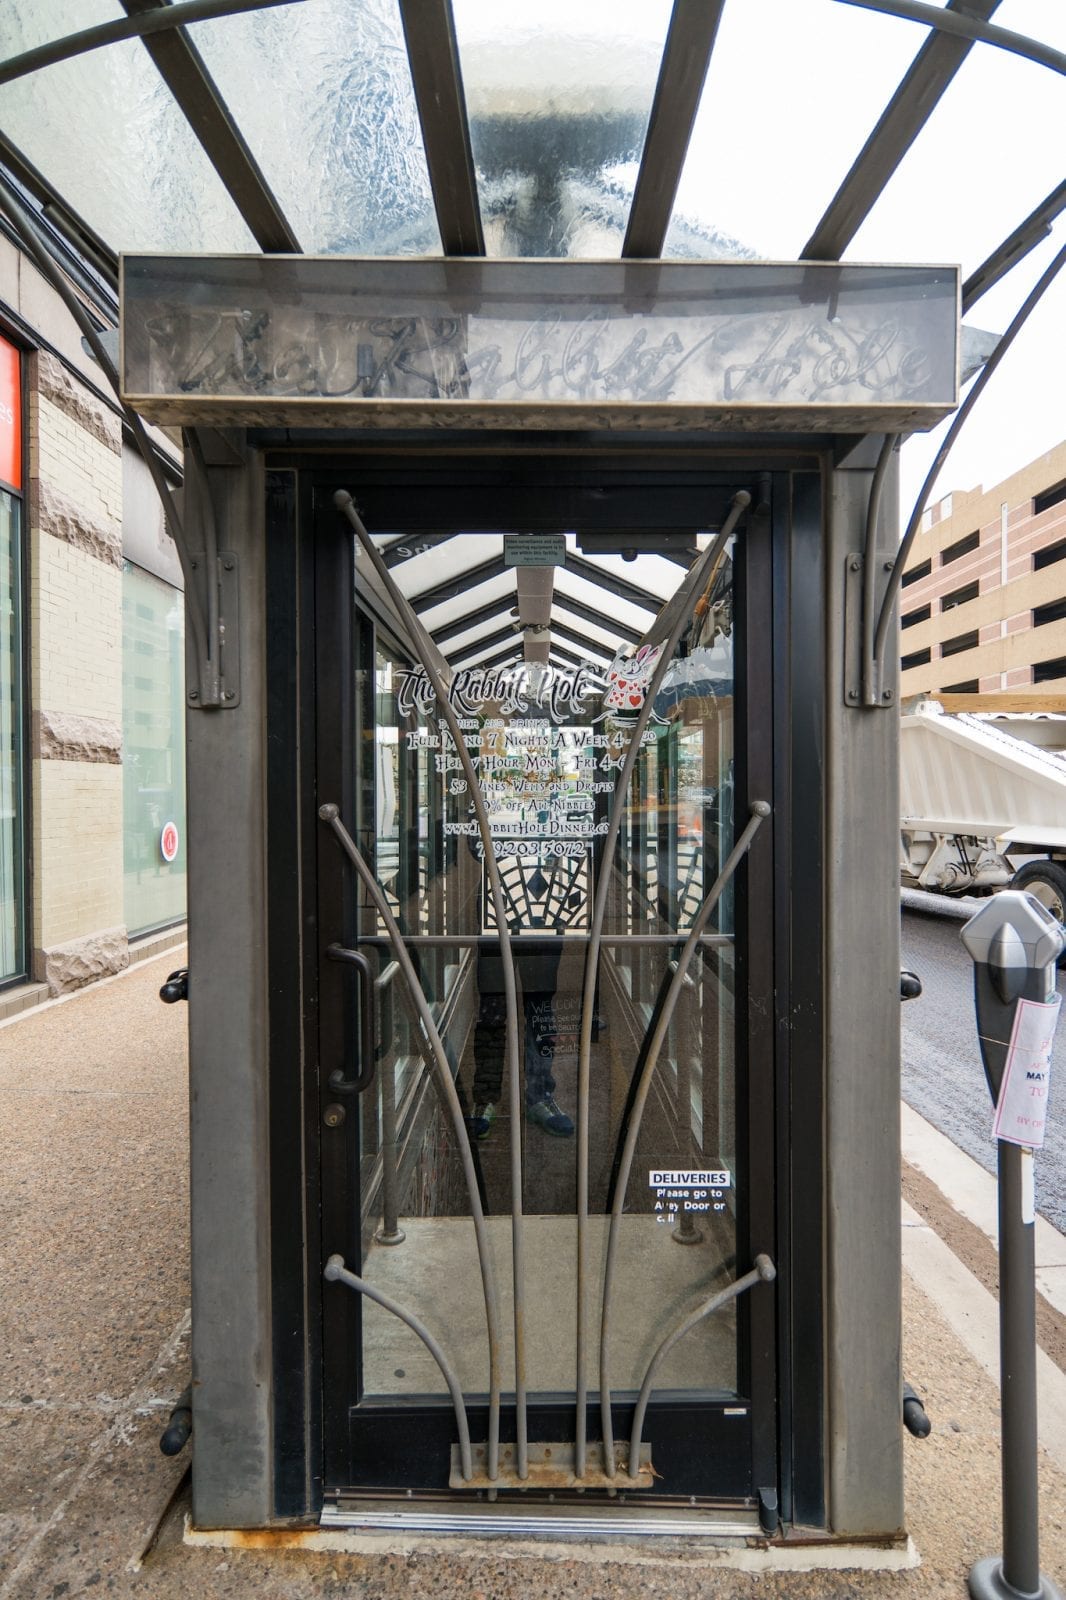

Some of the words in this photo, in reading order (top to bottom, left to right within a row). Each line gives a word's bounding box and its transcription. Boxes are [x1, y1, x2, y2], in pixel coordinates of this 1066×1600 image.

[448, 666, 528, 717] Rabbit
[537, 660, 599, 724] Hole
[439, 719, 479, 729] DNER
[484, 719, 504, 728] AND
[510, 719, 549, 729] DRINKS
[488, 732, 498, 749] 7
[551, 732, 566, 750] A
[475, 840, 588, 858] 79.203.5072
[653, 1173, 727, 1184] DELIVERIES
[693, 1190, 707, 1200] go
[710, 1189, 723, 1198] to
[683, 1201, 710, 1210] Door
